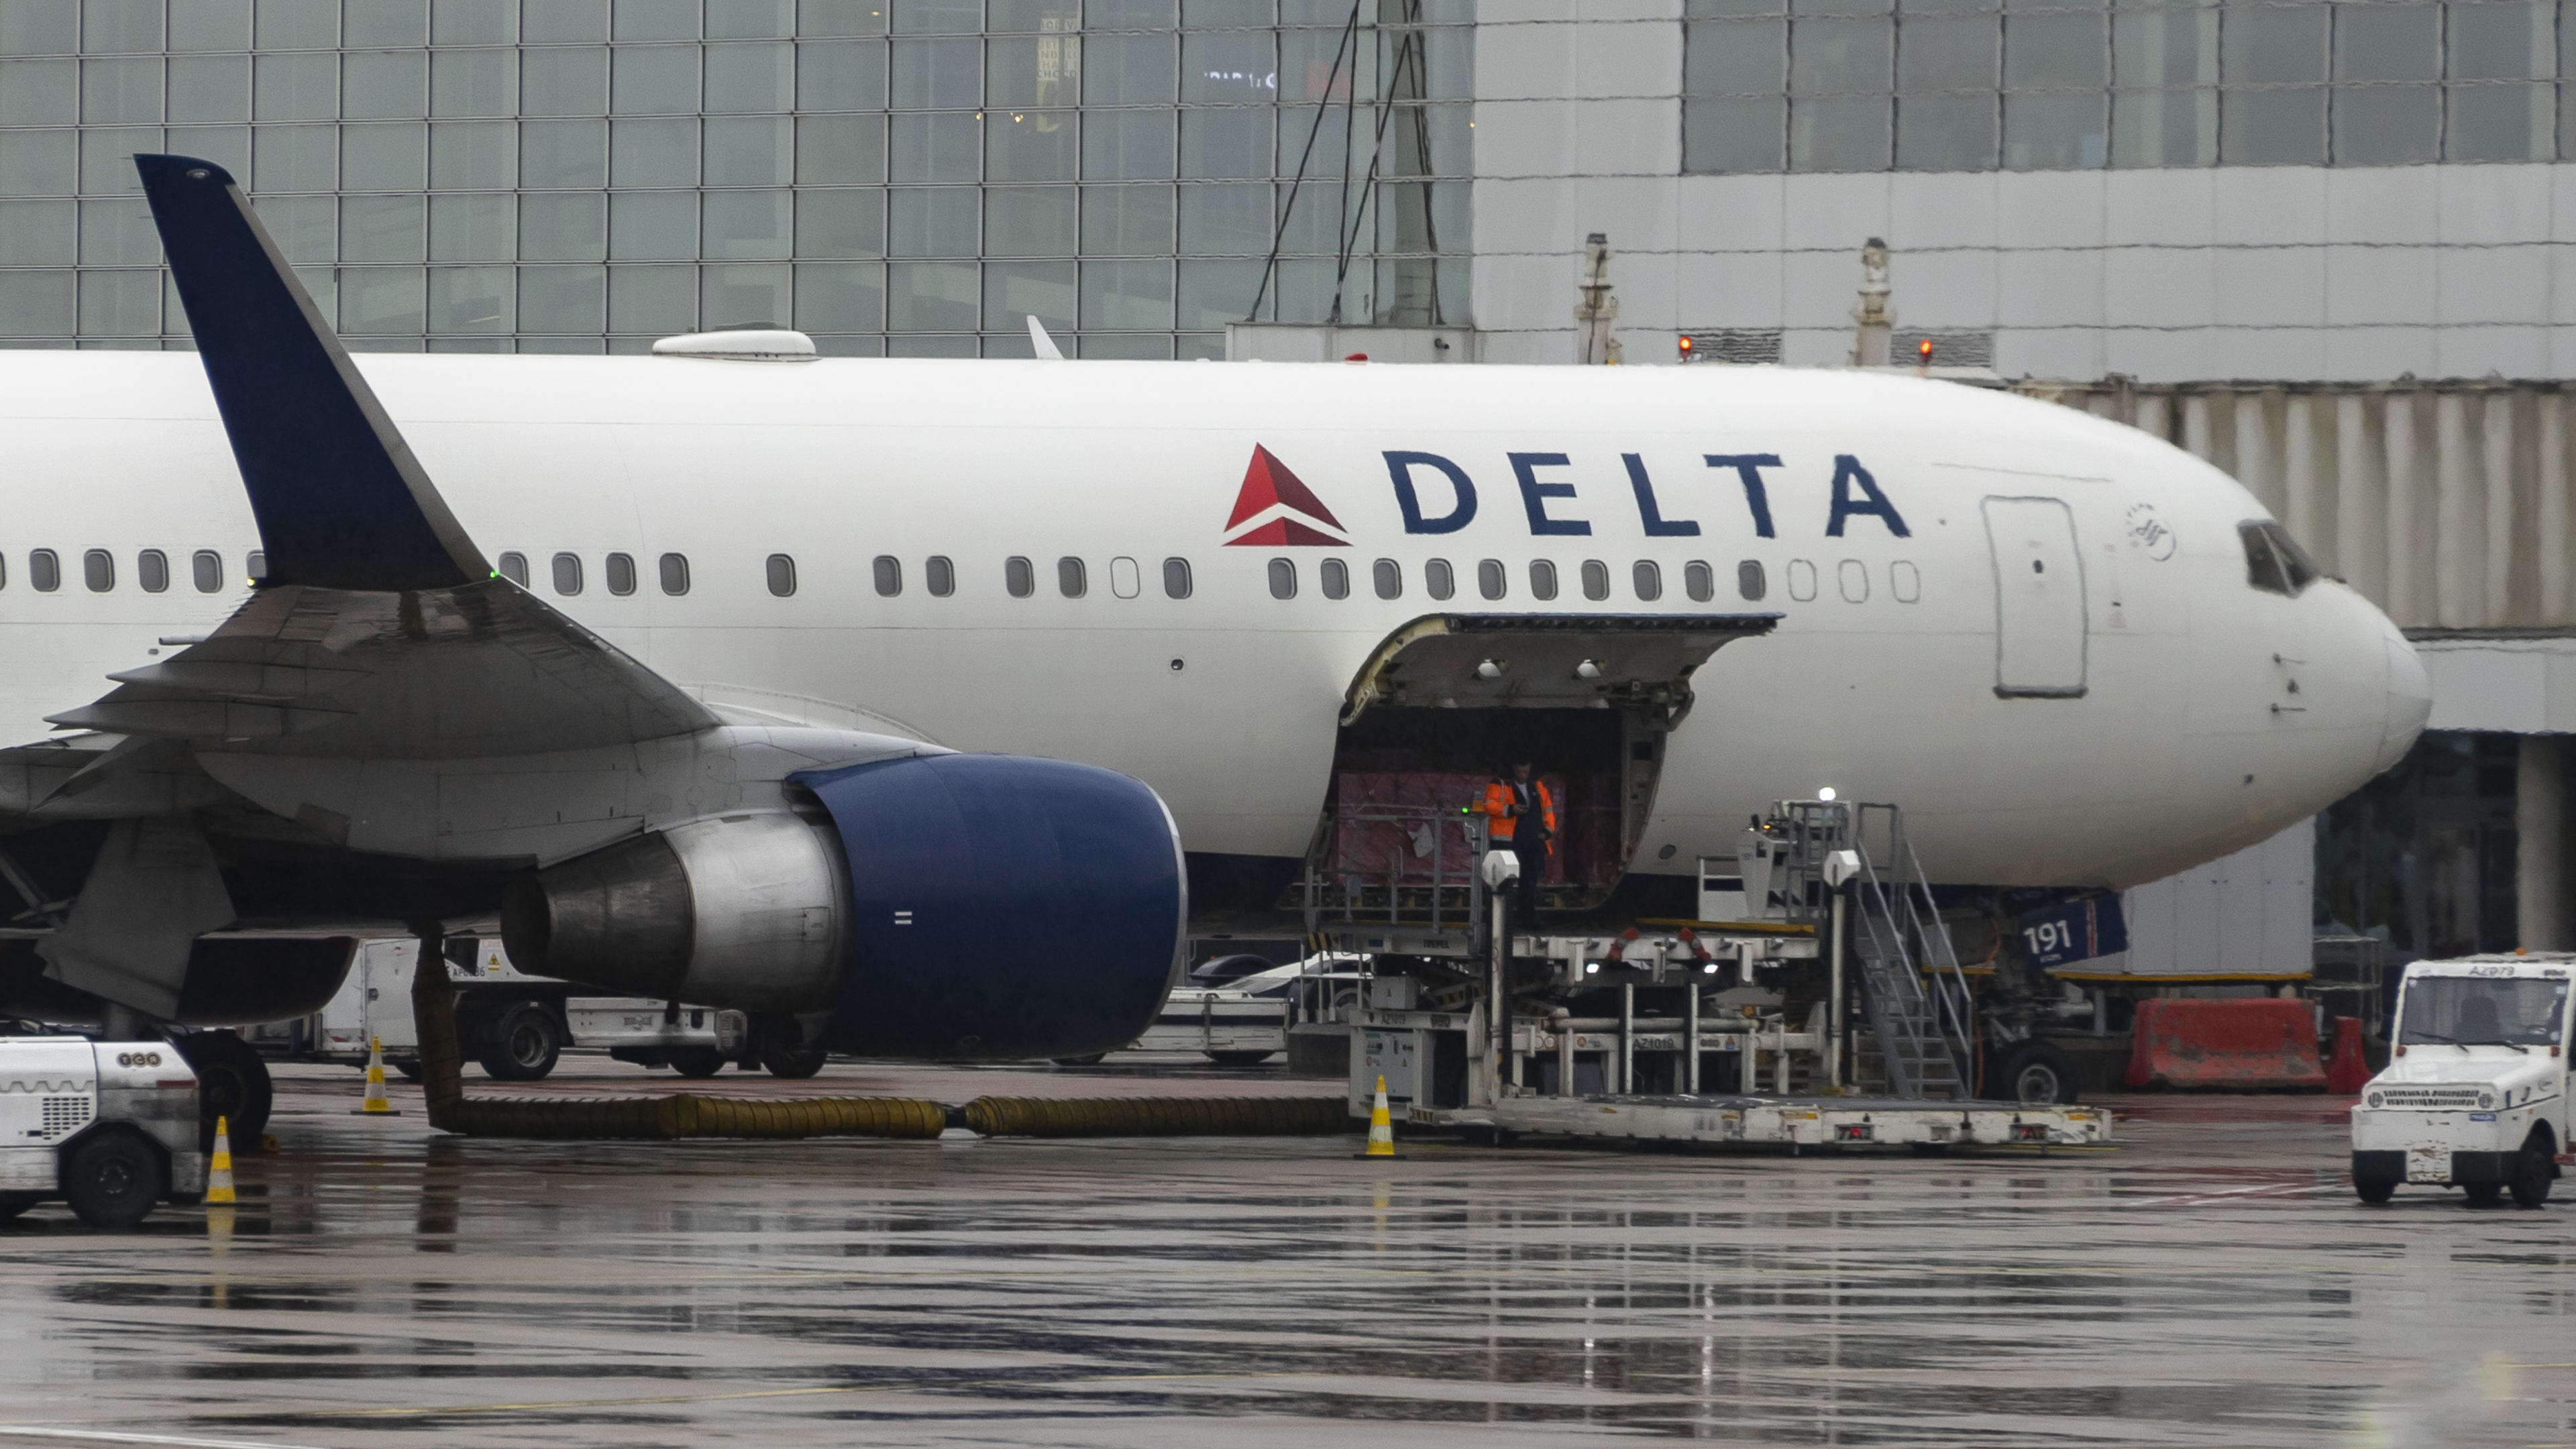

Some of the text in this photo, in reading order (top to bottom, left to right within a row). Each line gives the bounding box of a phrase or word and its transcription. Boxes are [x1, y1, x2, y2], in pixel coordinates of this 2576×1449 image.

[1382, 450, 1912, 539] DELTA
[2023, 919, 2072, 954] 191
[1633, 1038, 1674, 1049] AZ1019
